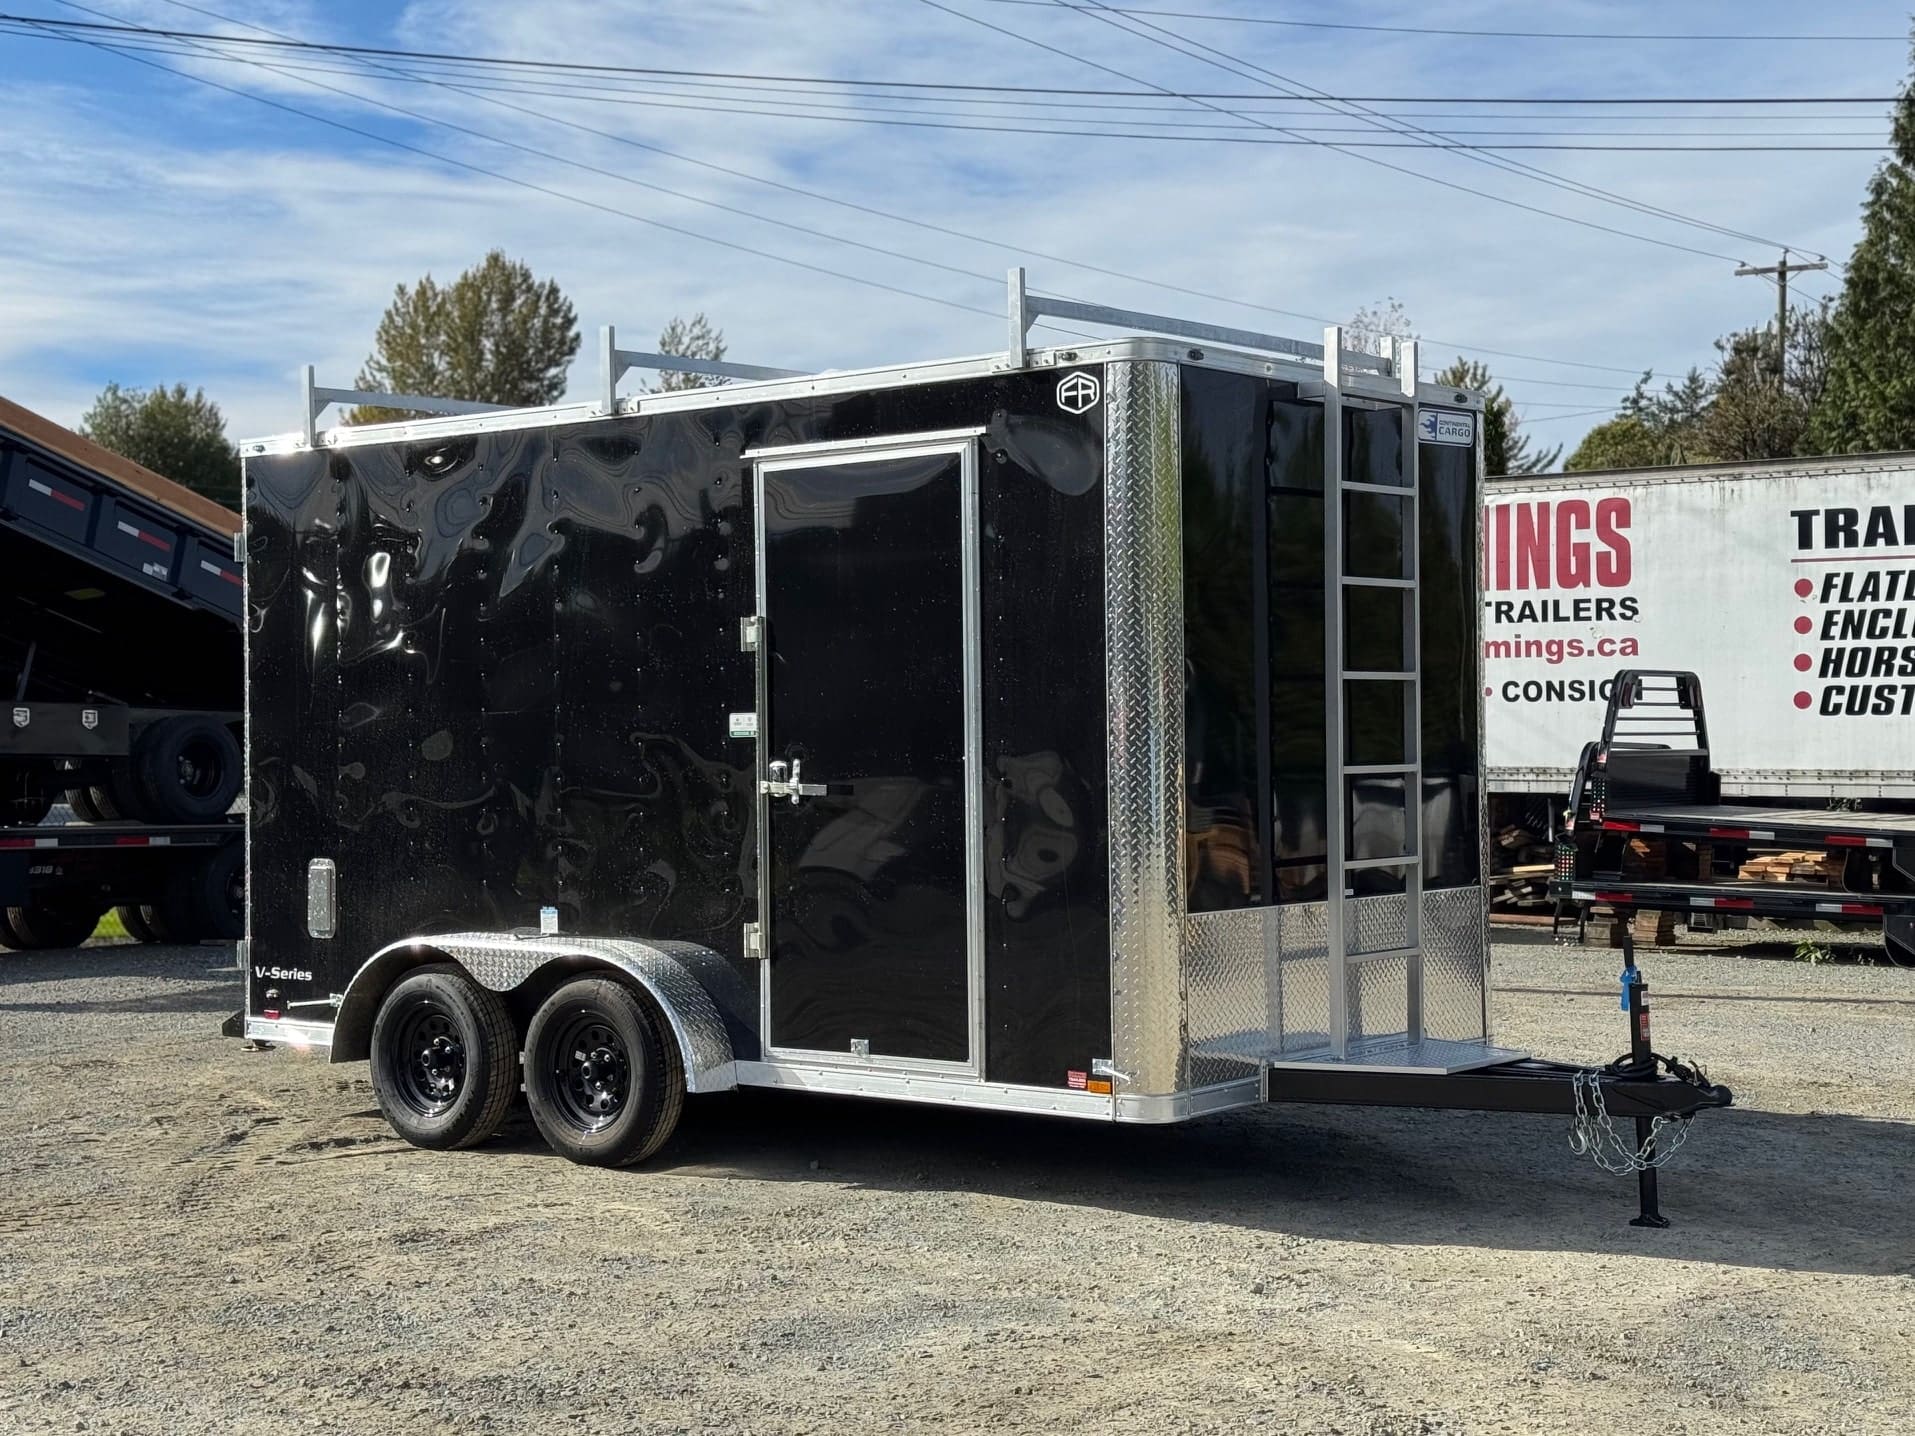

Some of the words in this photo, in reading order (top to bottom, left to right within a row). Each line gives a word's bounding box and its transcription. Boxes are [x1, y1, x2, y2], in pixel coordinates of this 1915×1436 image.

[1438, 426, 1471, 438] CARGO
[1485, 497, 1632, 592] INGS
[1820, 608, 1915, 641] ENCL
[255, 966, 313, 981] V-Series
